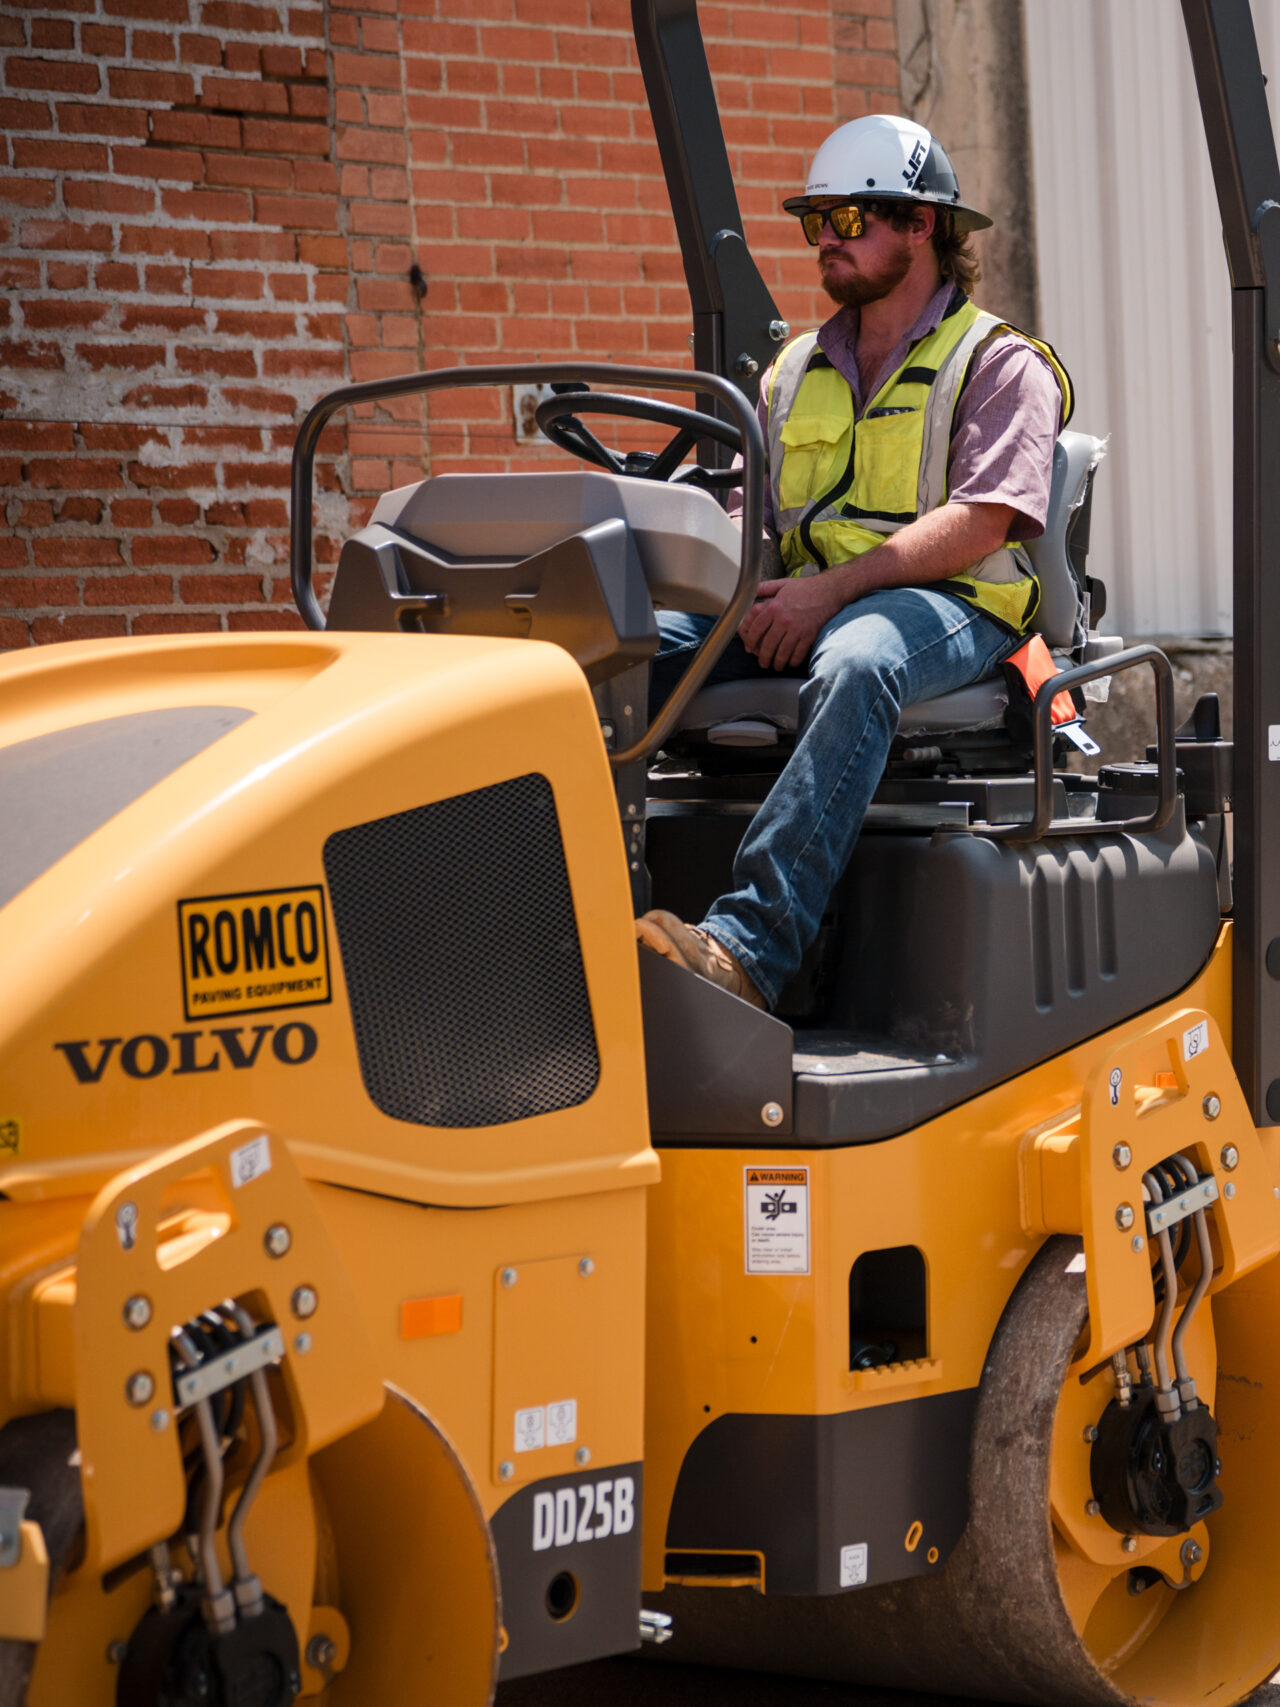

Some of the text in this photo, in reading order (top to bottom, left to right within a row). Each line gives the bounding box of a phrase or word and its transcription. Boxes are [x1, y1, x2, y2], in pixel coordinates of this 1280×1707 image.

[902, 139, 926, 180] LIFT
[188, 901, 319, 979] ROMCO
[192, 977, 323, 1005] PAVING EQUIPMENT
[53, 1022, 318, 1084] VOLVO
[760, 1172, 804, 1182] WARNING
[532, 1476, 635, 1552] DD25B
